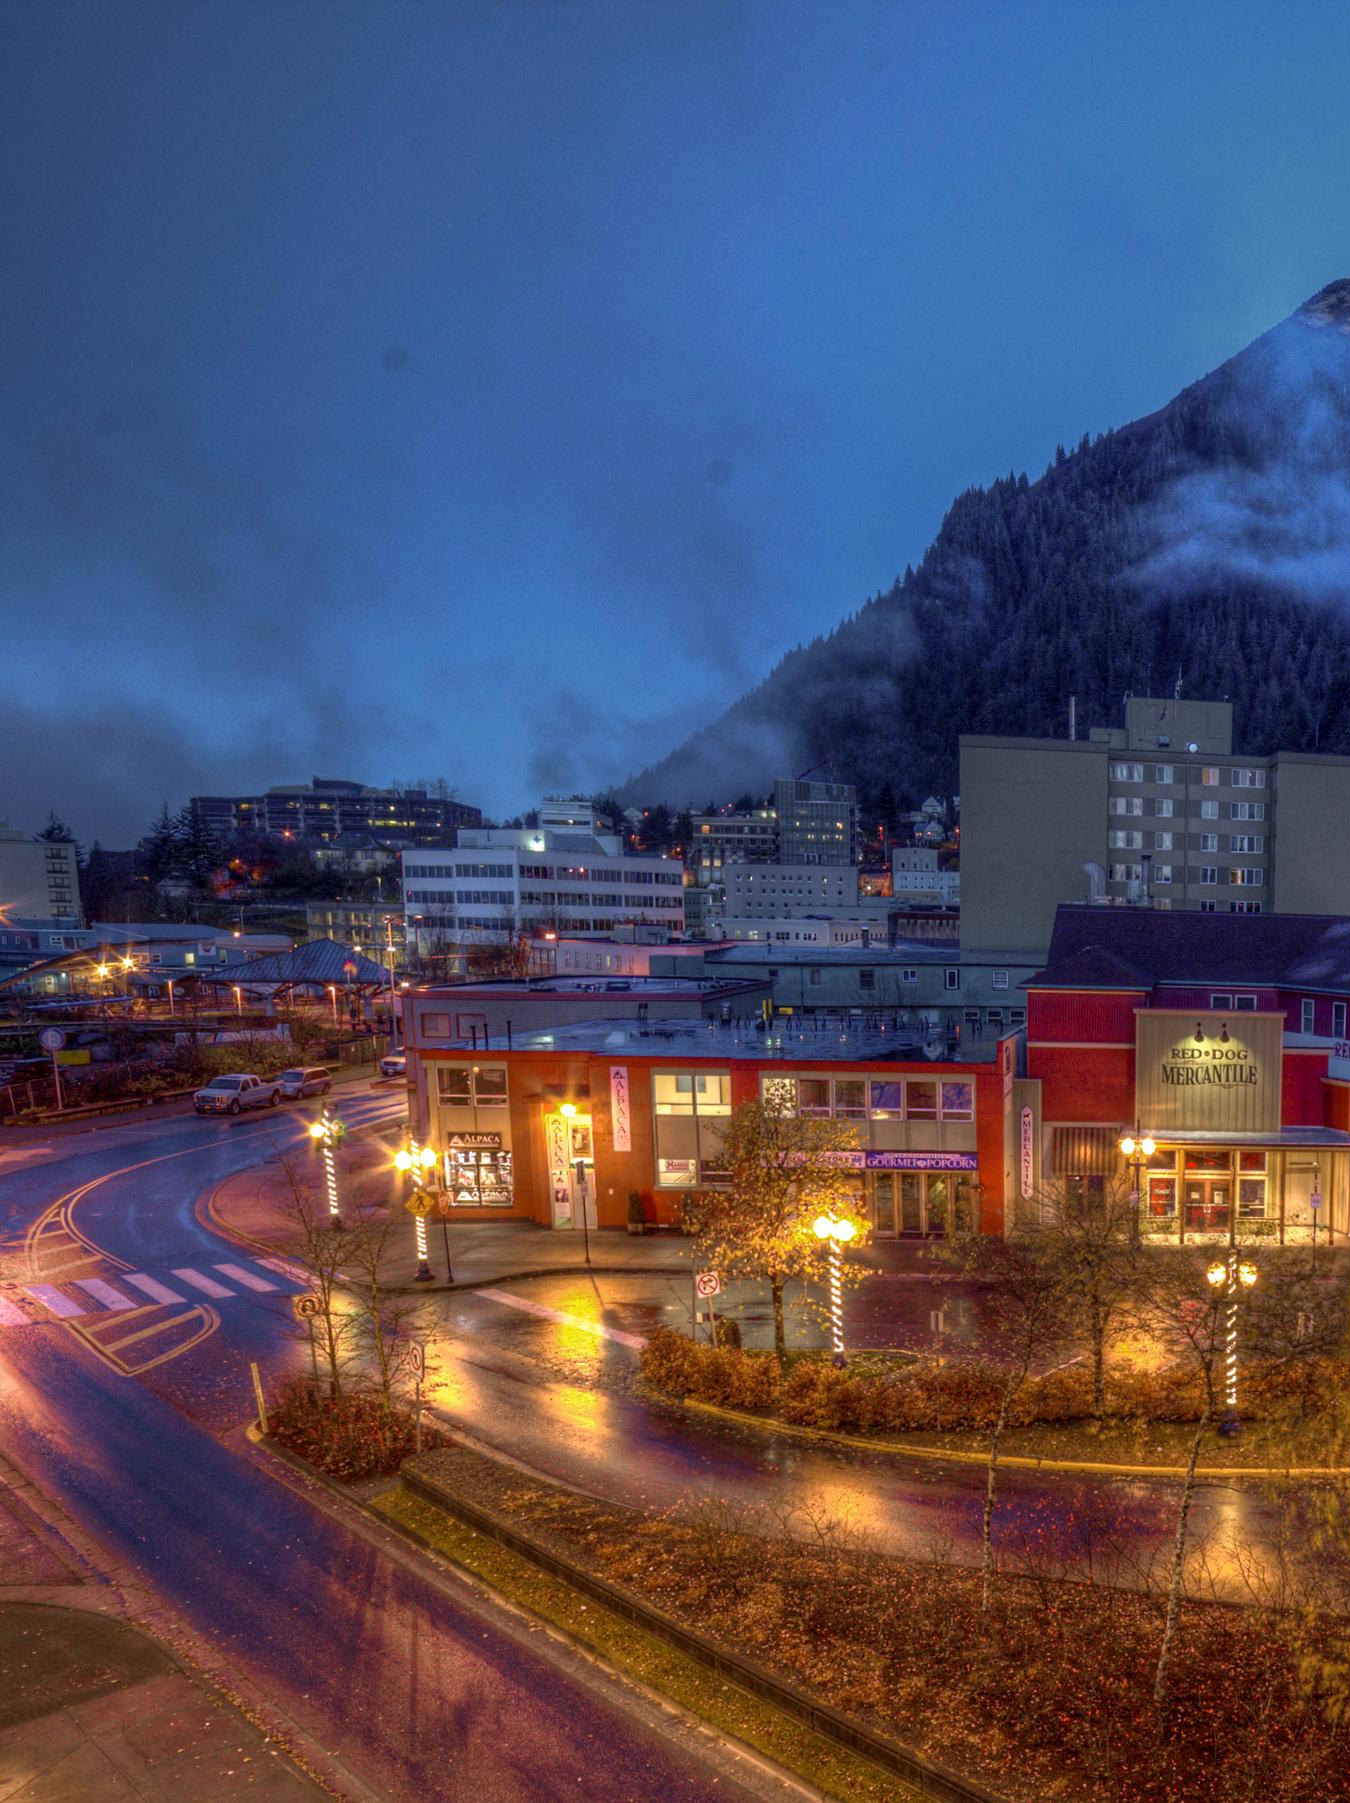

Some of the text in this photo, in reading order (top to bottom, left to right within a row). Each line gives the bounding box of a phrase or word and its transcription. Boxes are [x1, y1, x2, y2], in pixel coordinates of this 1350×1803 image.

[1171, 1048, 1248, 1060] RED DOG
[1161, 1063, 1257, 1085] MERCANTILE
[615, 1080, 627, 1134] ALPACA
[464, 1133, 500, 1143] ALPACA
[927, 1159, 977, 1168] POPCORN
[1023, 1120, 1032, 1195] MERCANTILE
